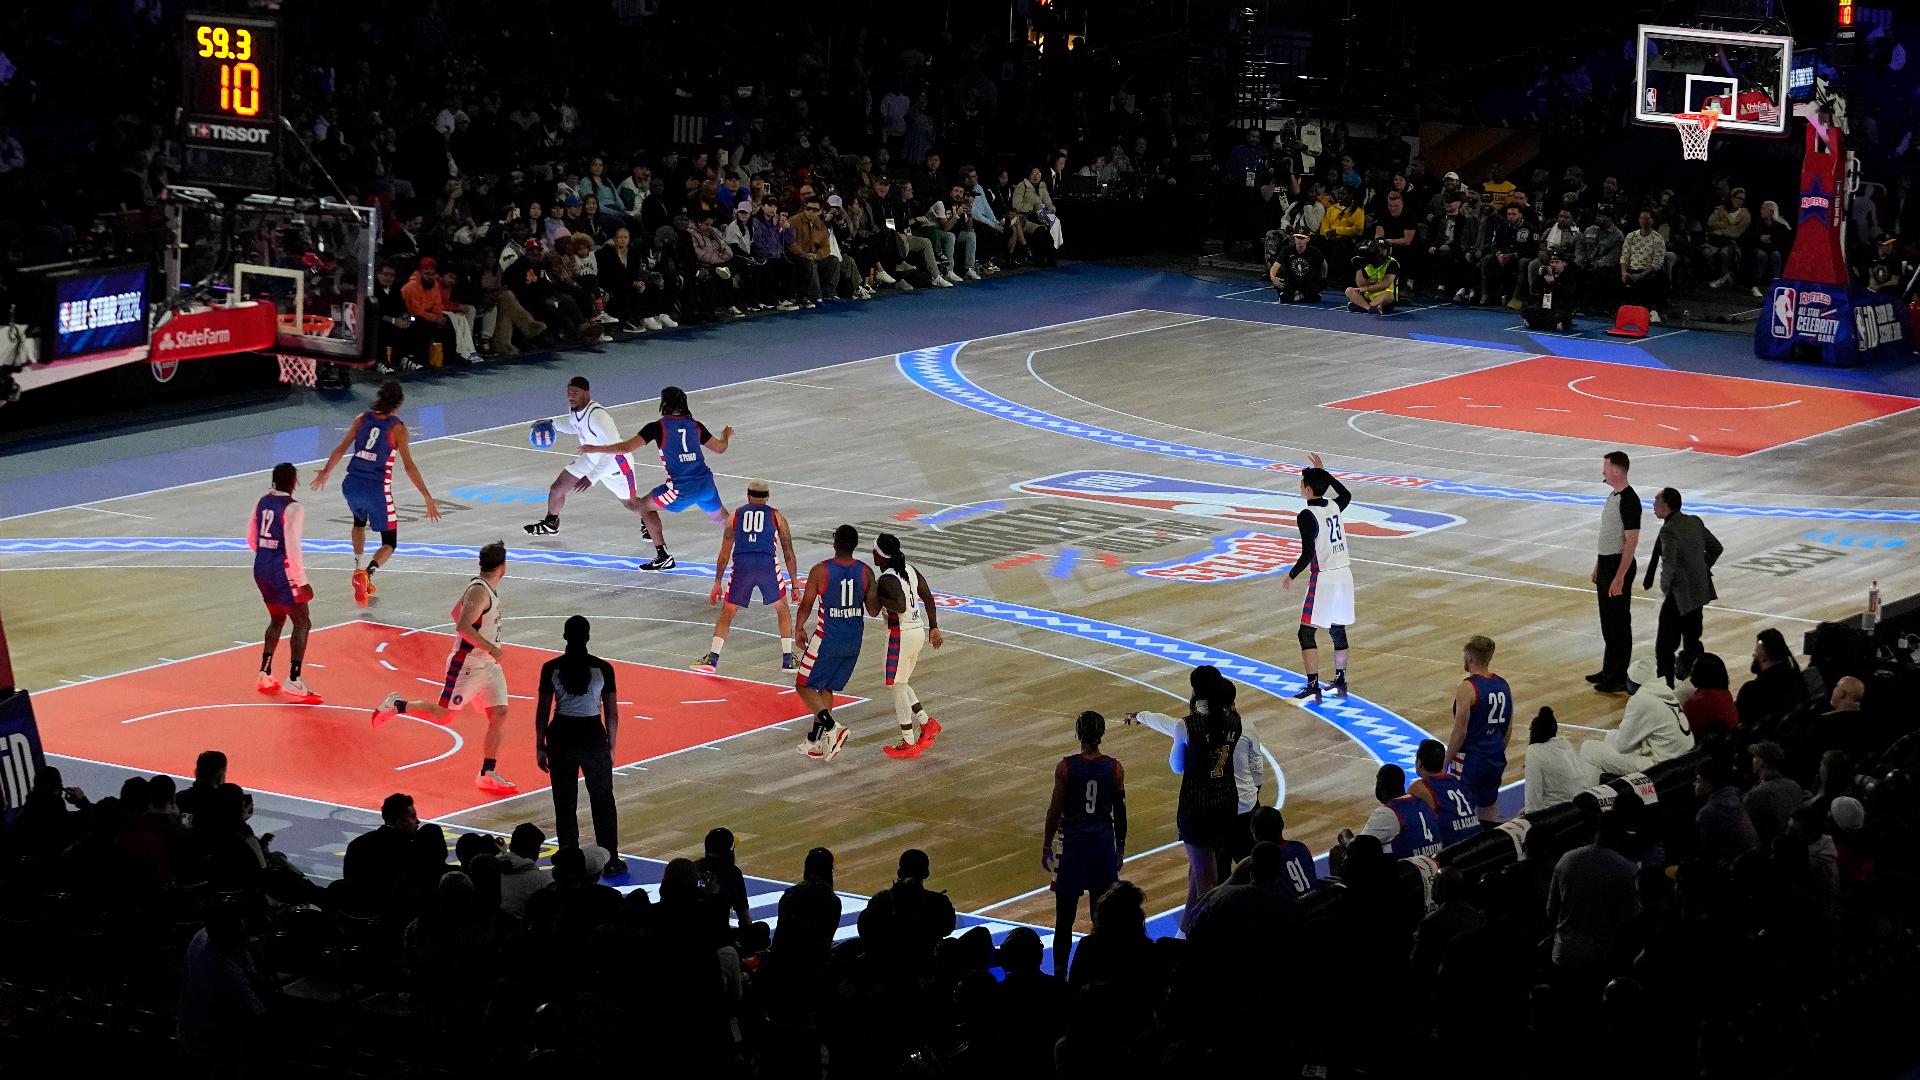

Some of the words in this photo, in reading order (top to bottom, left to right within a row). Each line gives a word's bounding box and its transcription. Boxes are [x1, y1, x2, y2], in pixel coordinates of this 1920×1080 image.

[197, 26, 251, 60] 59.3
[220, 62, 259, 116] 10
[210, 124, 270, 144] TISSOT
[1796, 315, 1840, 336] CELEBRITY
[677, 428, 689, 453] 7
[259, 508, 275, 538] 12
[742, 510, 765, 533] 00
[1325, 514, 1342, 544] 23
[748, 533, 758, 543] AJ
[840, 578, 855, 607] 11
[1487, 691, 1507, 724] 22
[1085, 779, 1098, 814] 9
[1447, 788, 1473, 817] 21
[1418, 811, 1434, 842] 4
[1285, 857, 1311, 893] 91
